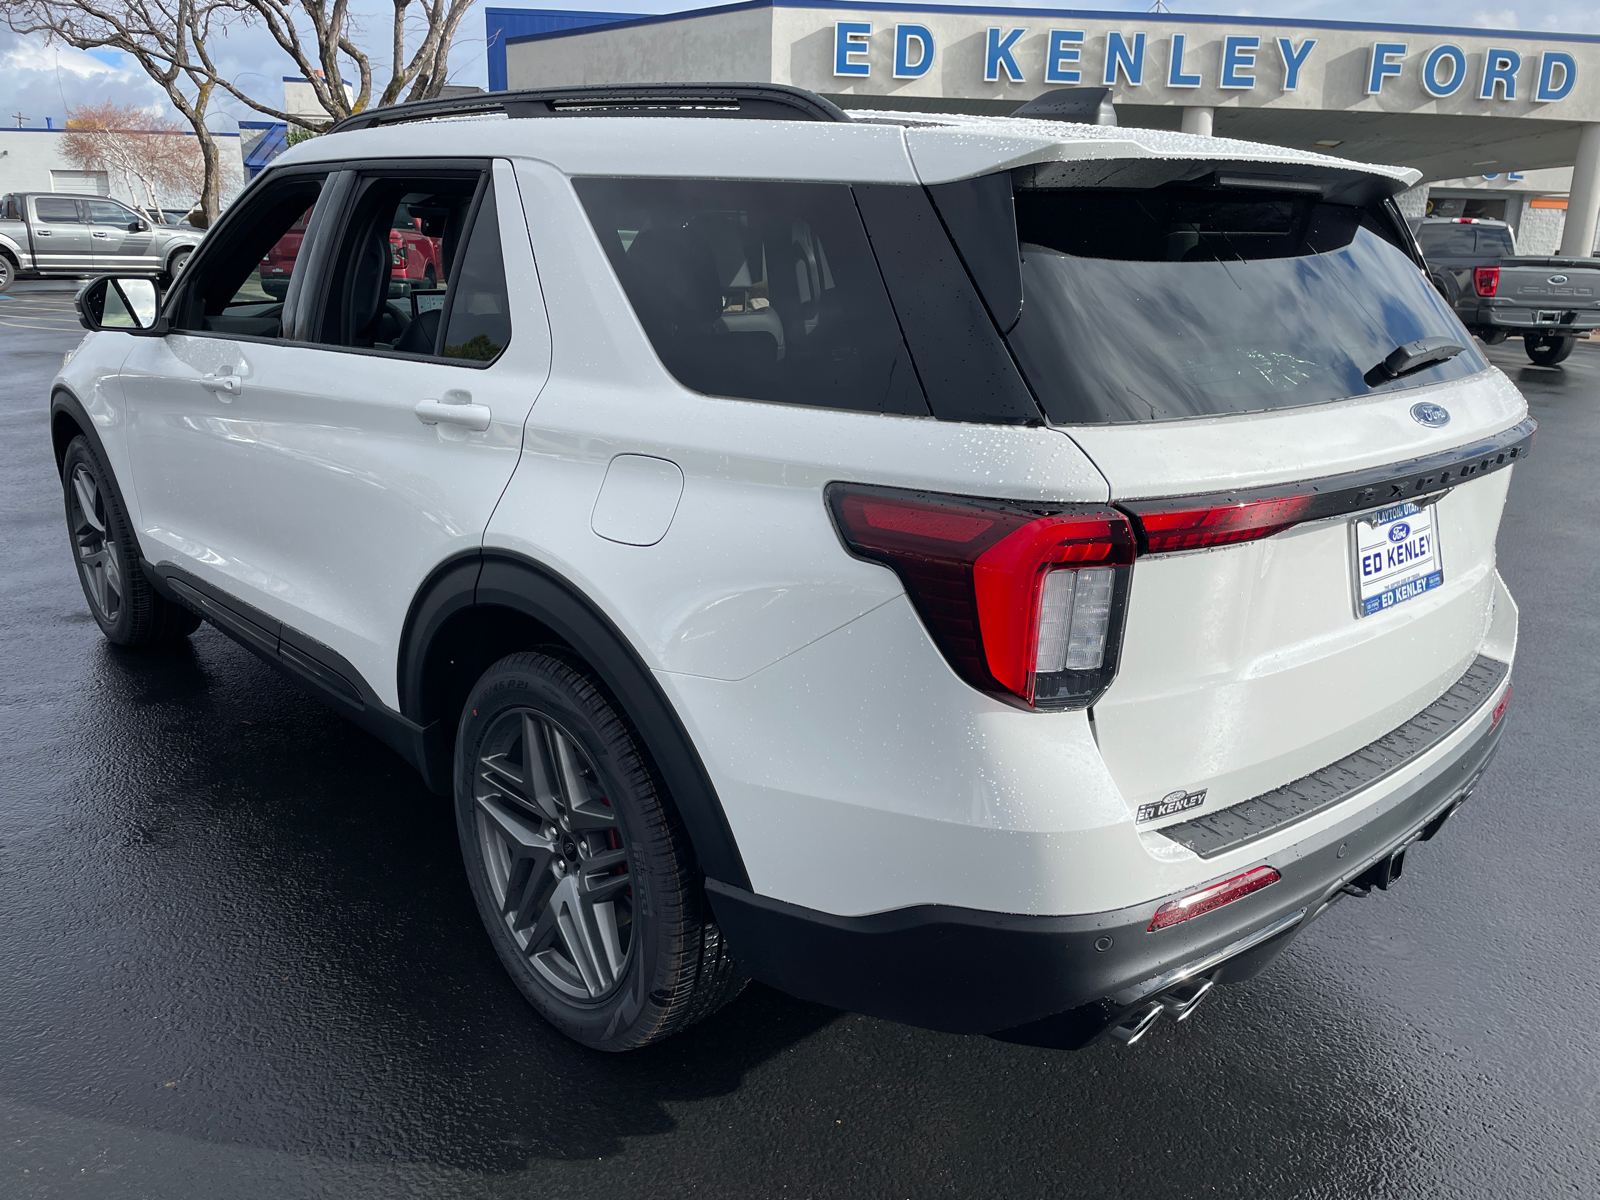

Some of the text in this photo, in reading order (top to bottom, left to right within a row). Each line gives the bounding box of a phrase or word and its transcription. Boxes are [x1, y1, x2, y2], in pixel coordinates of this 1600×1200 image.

[833, 20, 1579, 103] ED KENLEY FORD
[1516, 285, 1593, 297] F-150
[1354, 445, 1523, 506] EXPLORER
[1362, 533, 1431, 576] ED KENLEY
[1381, 592, 1394, 608] ED
[1395, 577, 1427, 603] KENLEY
[1137, 807, 1155, 821] ED
[1157, 793, 1206, 816] KENLEY
